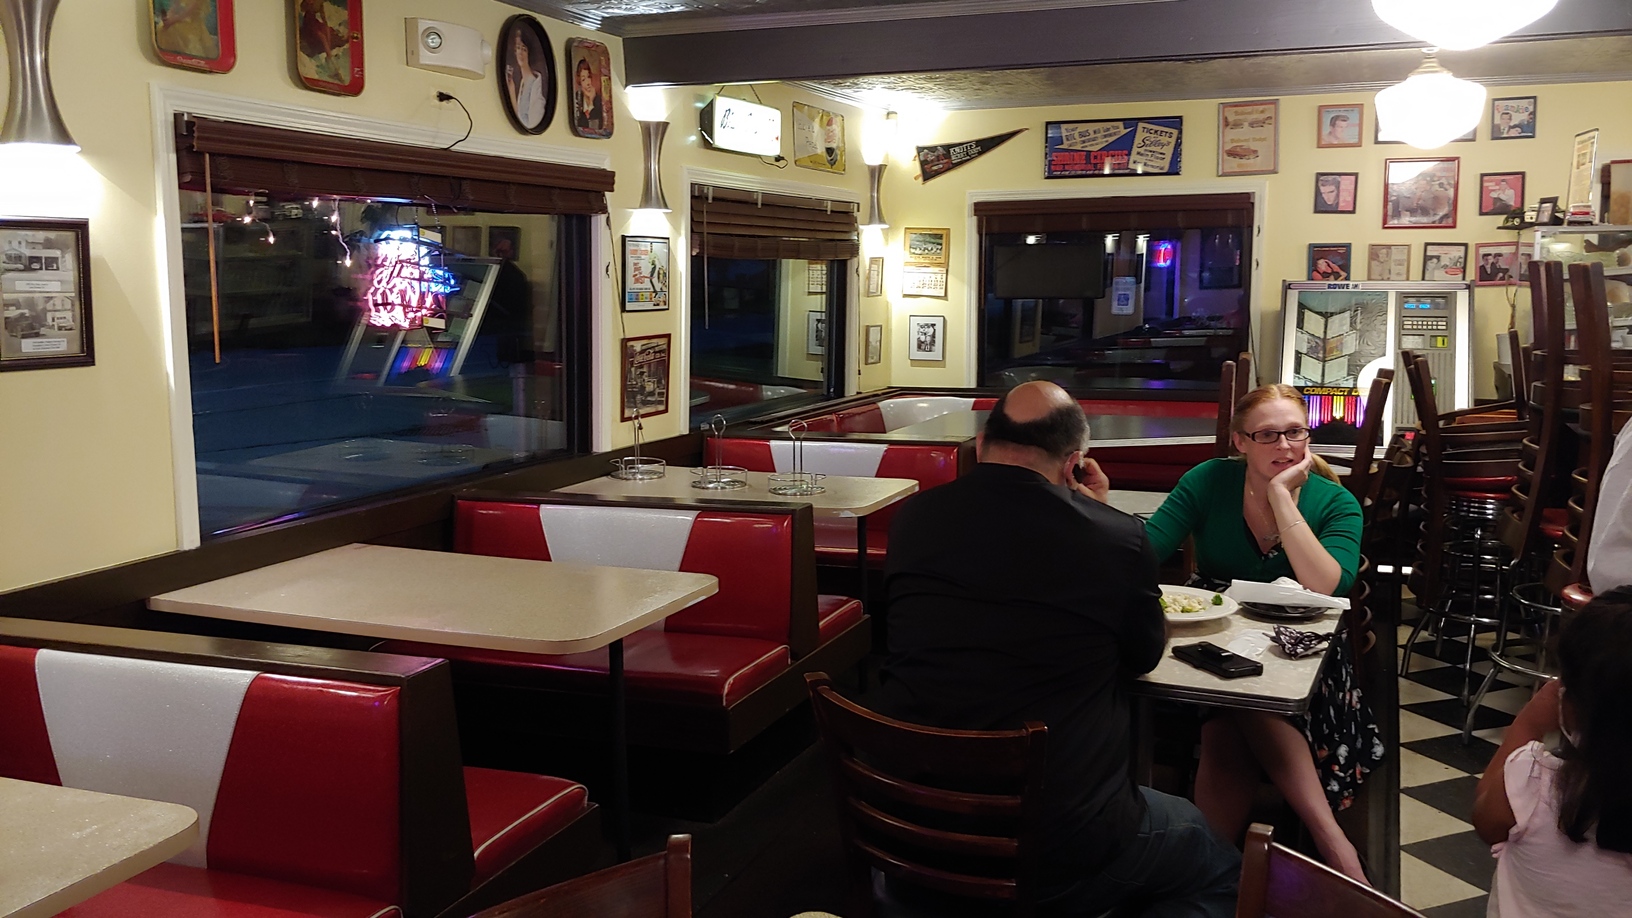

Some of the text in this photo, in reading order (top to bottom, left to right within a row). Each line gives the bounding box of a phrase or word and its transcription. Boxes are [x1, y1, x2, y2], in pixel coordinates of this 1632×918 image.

[1141, 126, 1174, 139] TICKETS
[1090, 150, 1128, 164] CIRCUS
[1303, 387, 1350, 396] COMPACT
